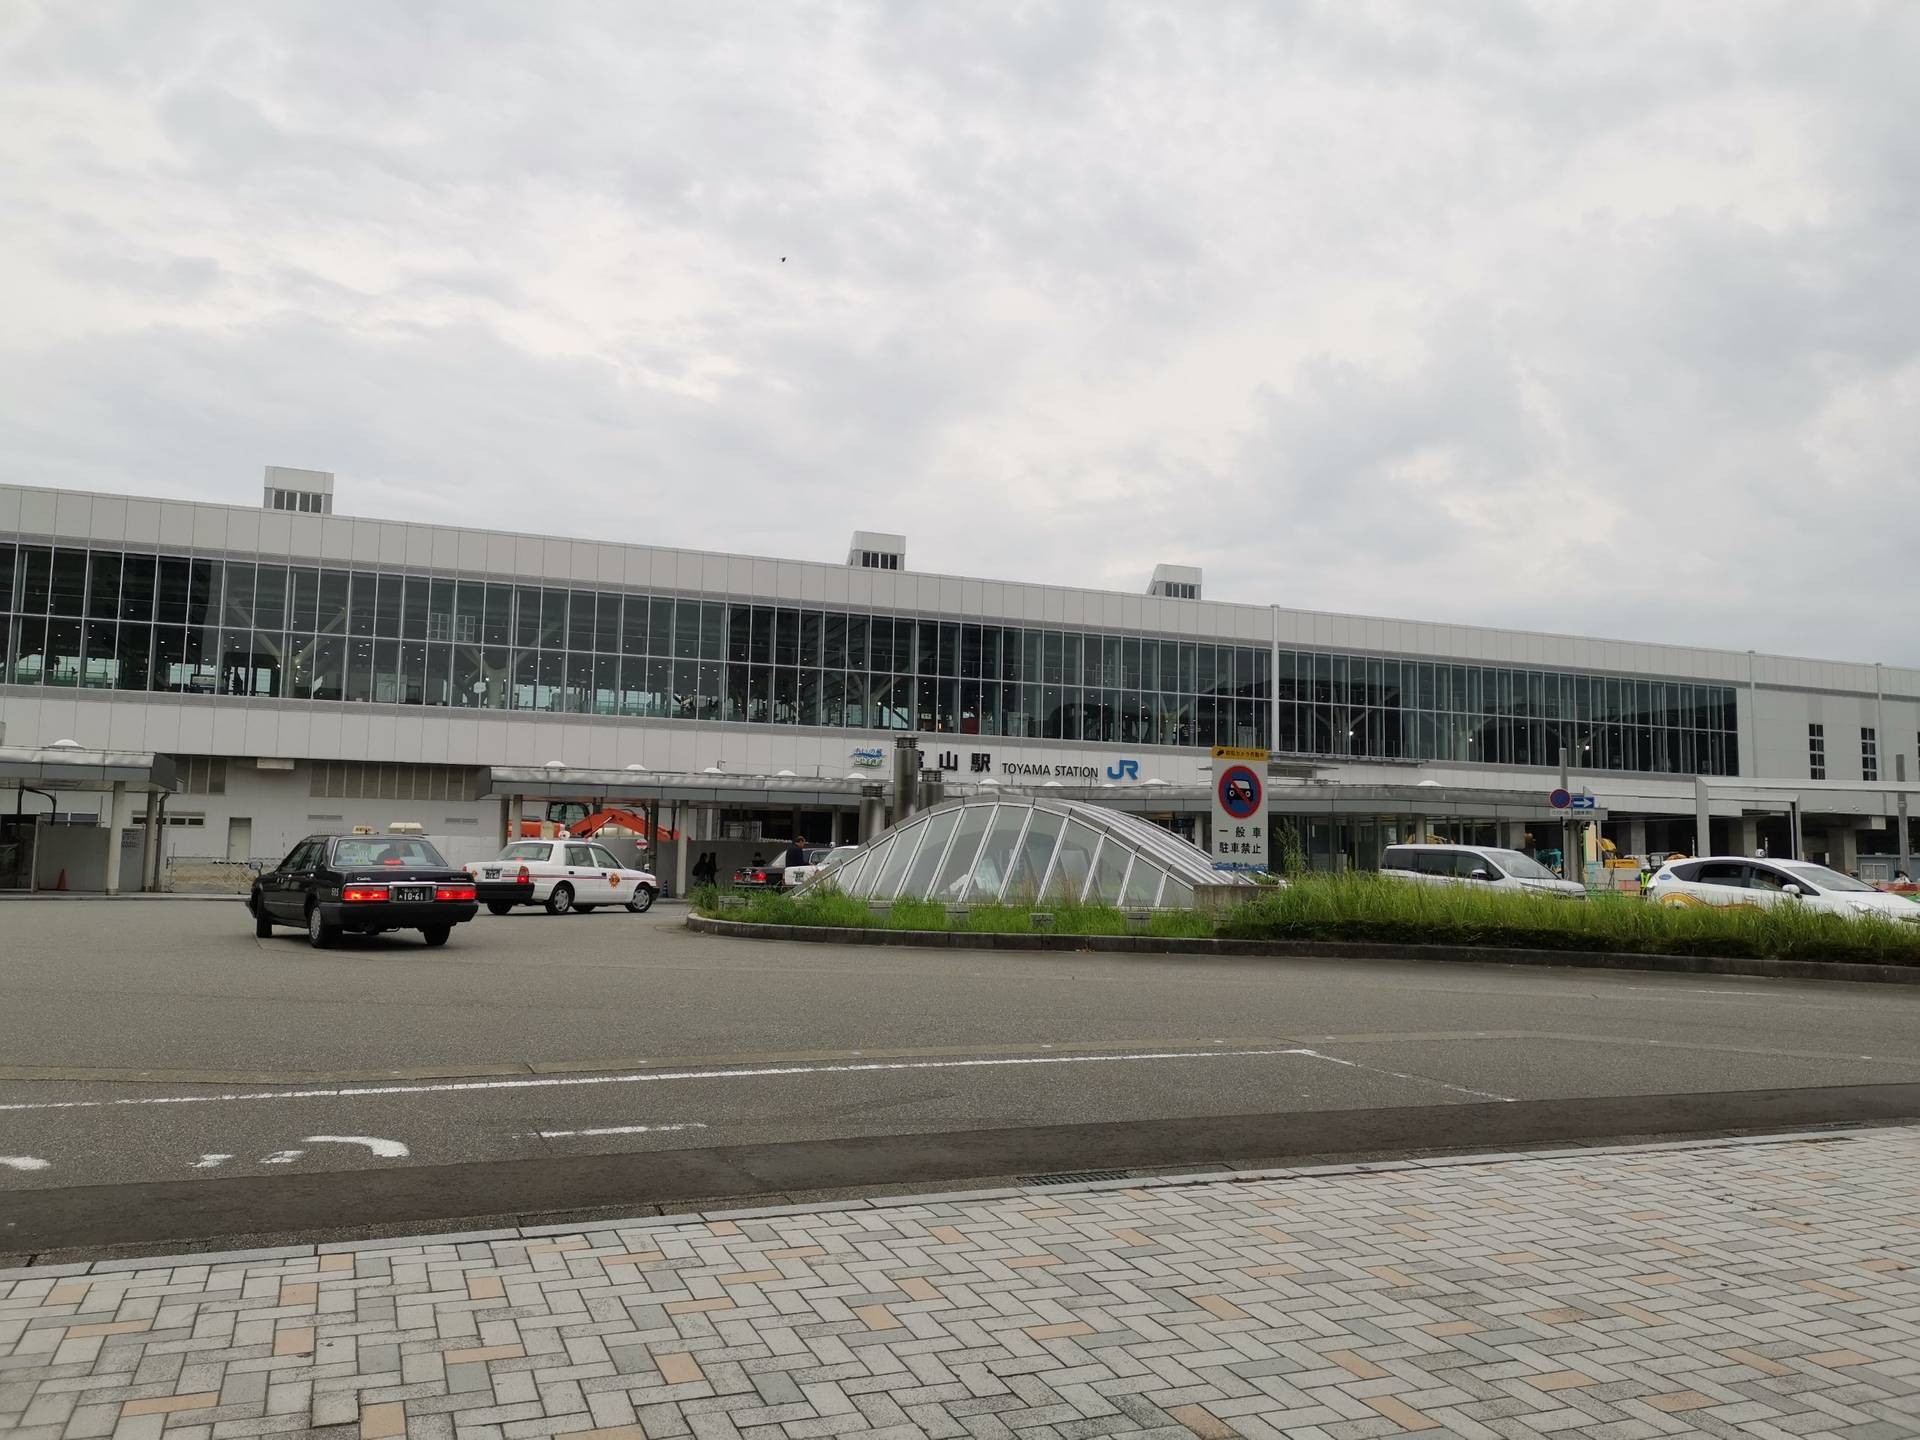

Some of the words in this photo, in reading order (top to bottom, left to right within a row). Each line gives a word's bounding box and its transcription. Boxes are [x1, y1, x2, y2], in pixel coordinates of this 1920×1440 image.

[1002, 762, 1051, 776] TOYAMA
[1054, 764, 1099, 778] STATION
[1107, 759, 1139, 781] JR
[1218, 826, 1262, 838] 一般車
[1218, 842, 1262, 854] 駐車禁止
